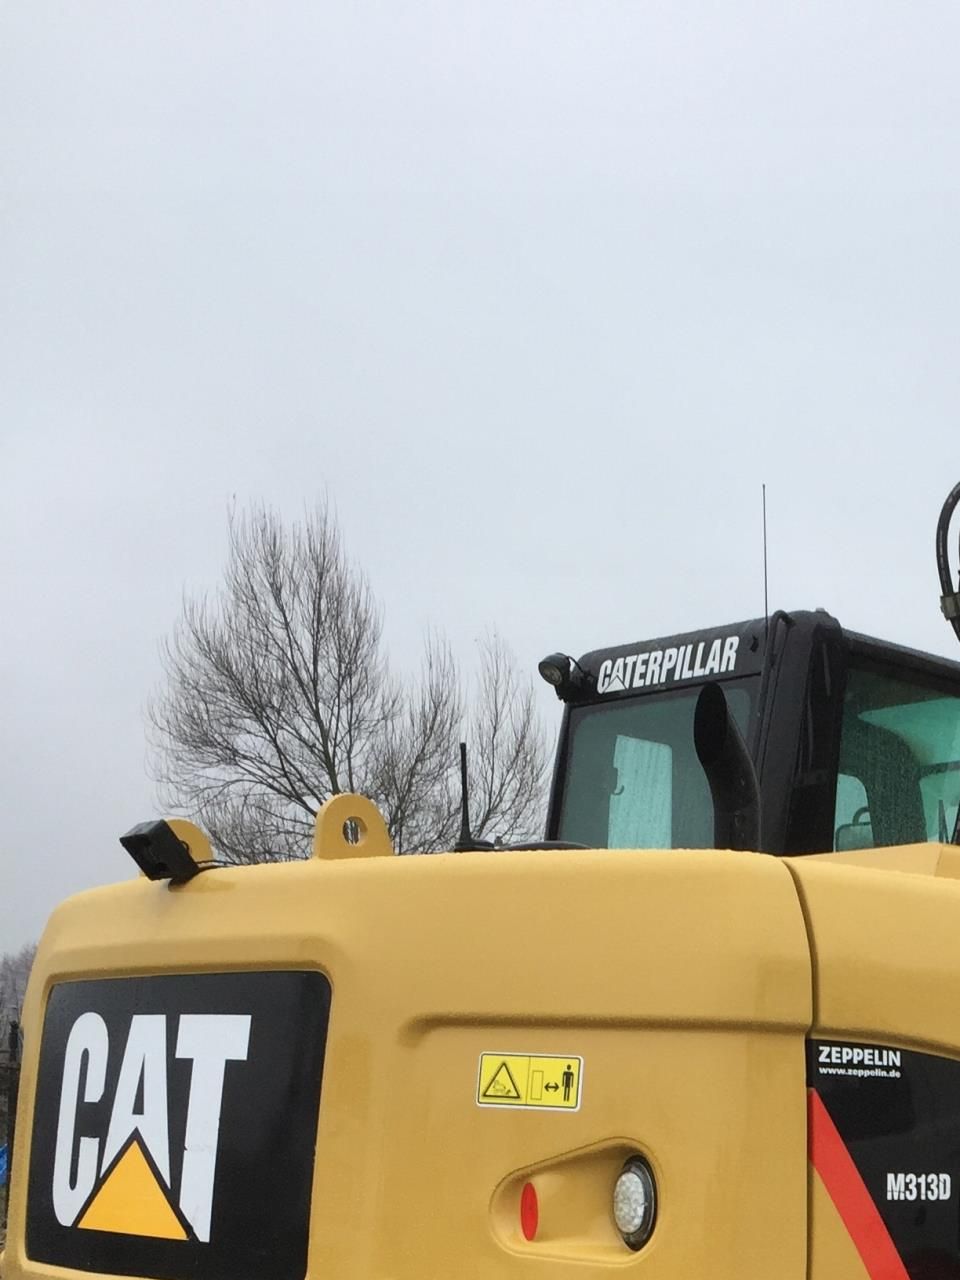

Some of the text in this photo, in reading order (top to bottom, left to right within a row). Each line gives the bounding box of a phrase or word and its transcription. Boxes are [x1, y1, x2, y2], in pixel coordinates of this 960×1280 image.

[597, 636, 739, 695] CATERPILLAR
[818, 1046, 901, 1066] ZEPPELIN
[818, 1066, 901, 1078] www.zeppelin.de
[53, 1012, 252, 1243] CAT
[886, 1172, 951, 1201] M313D
